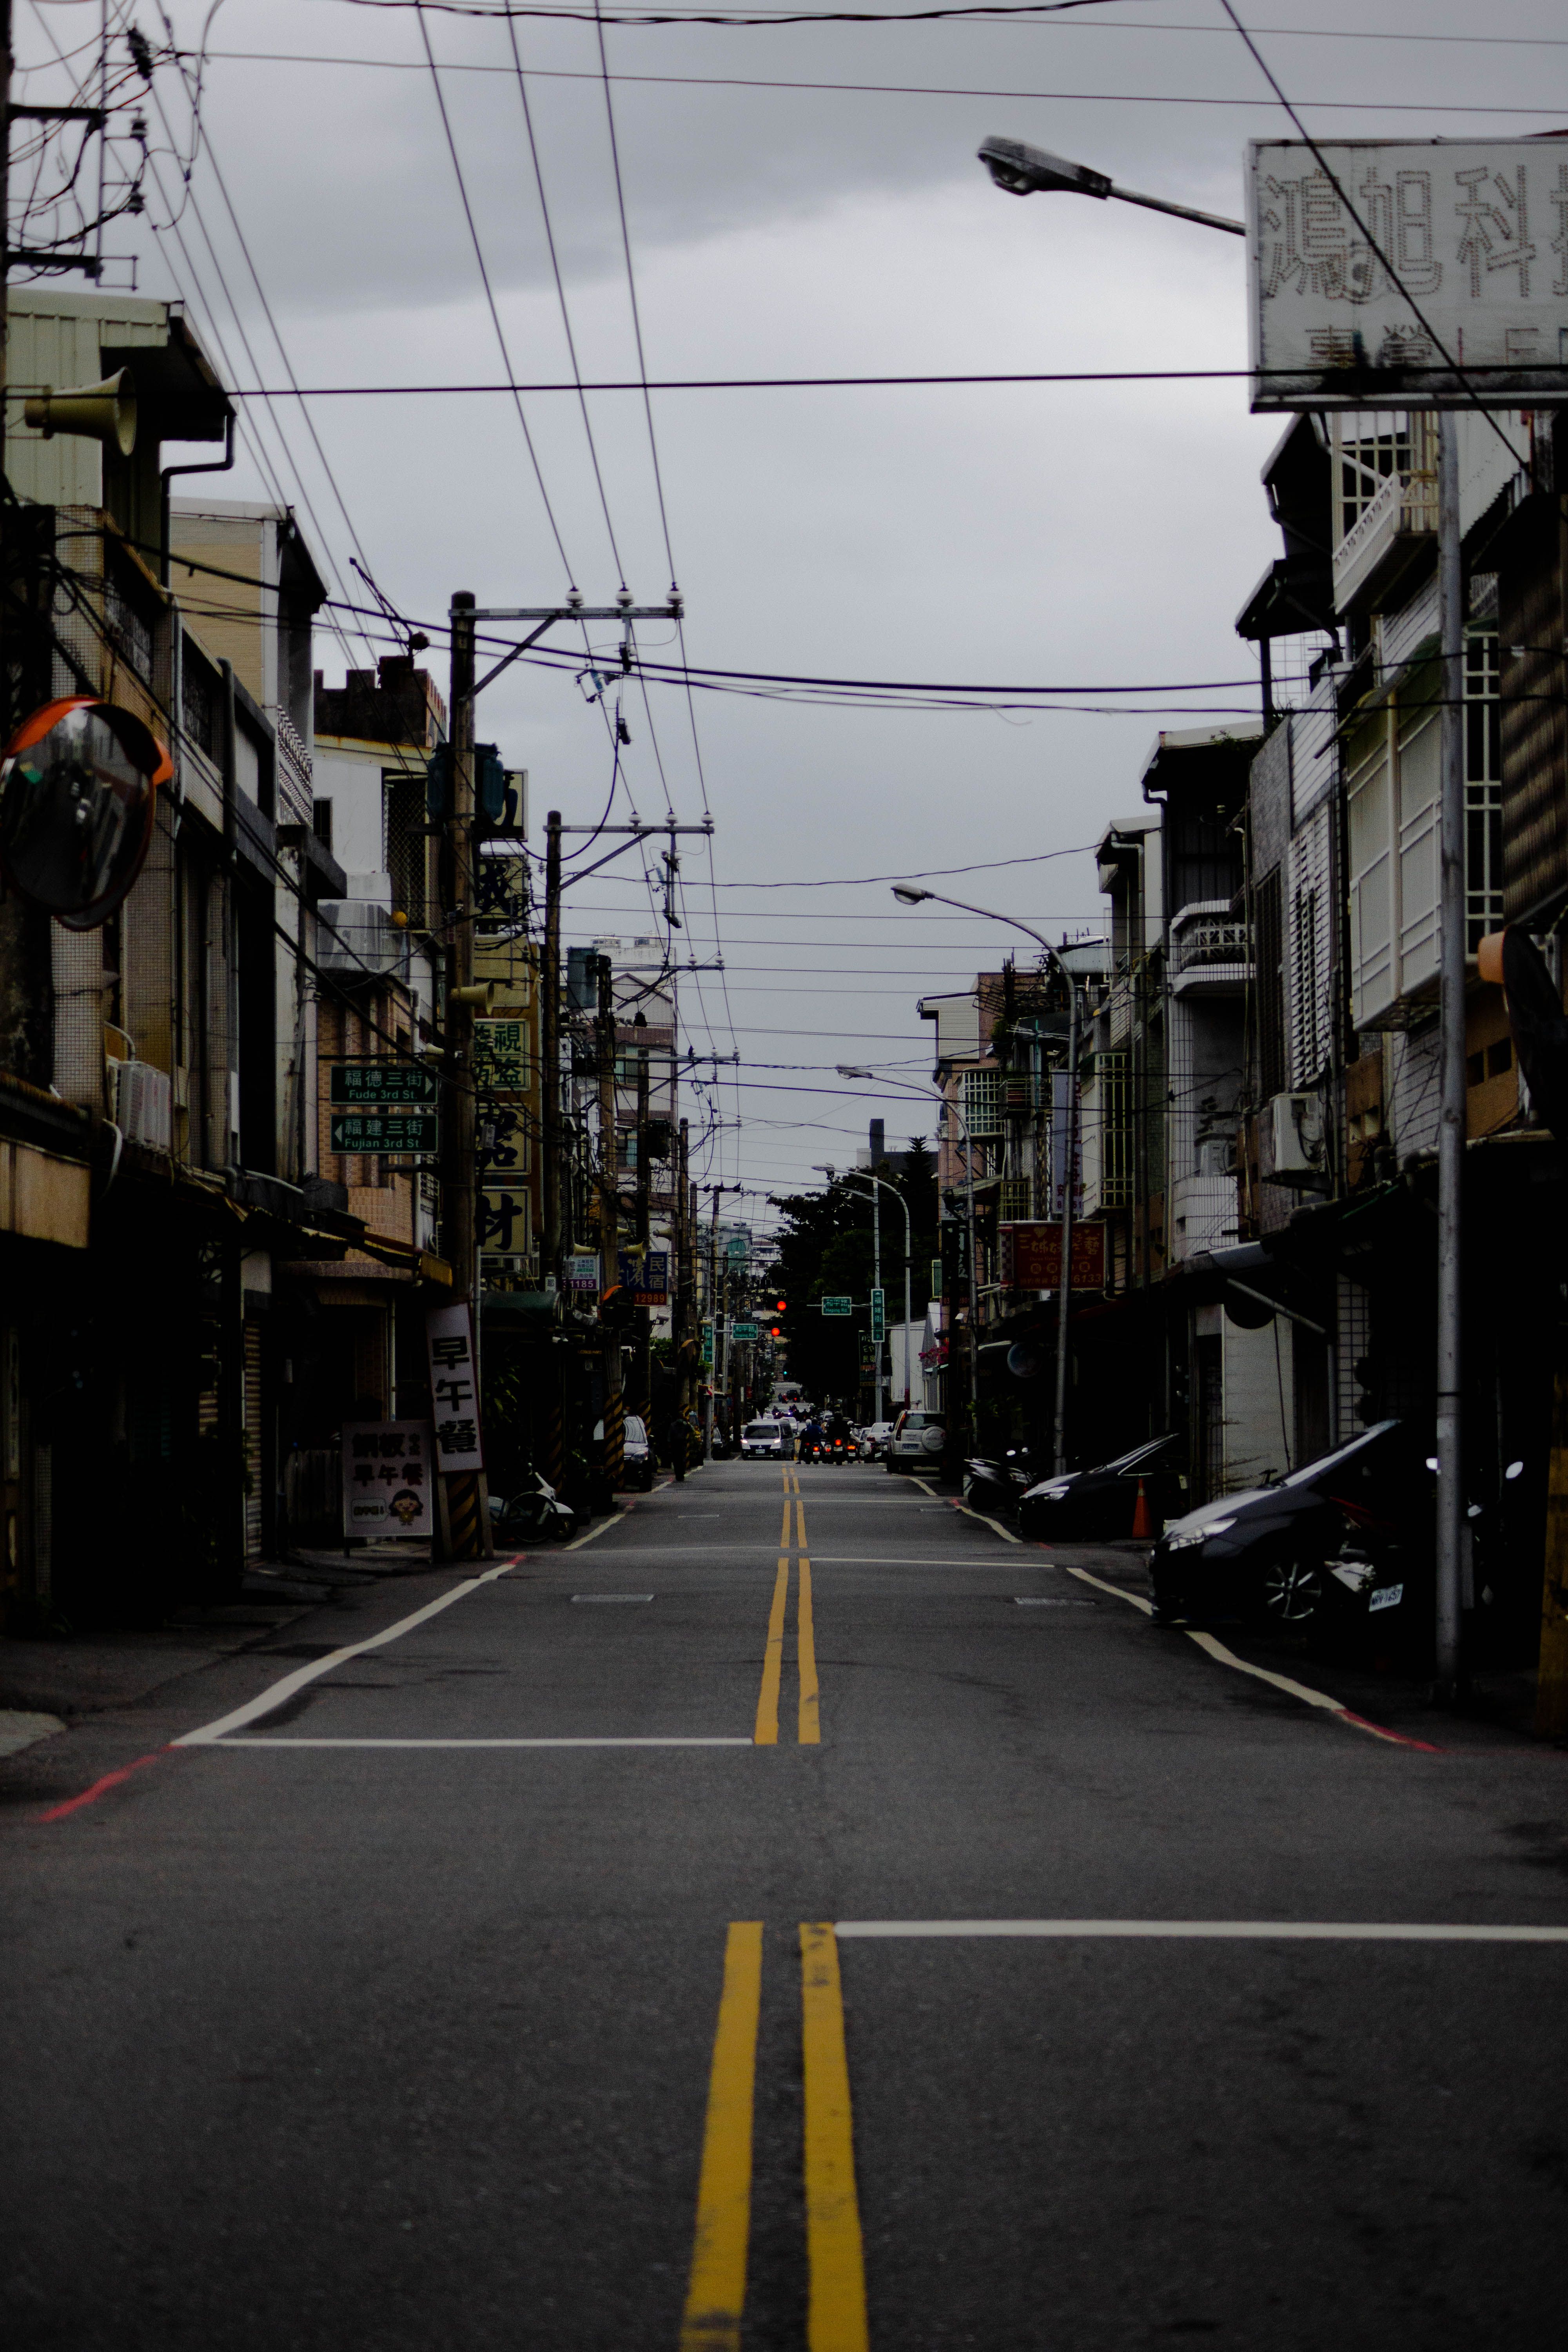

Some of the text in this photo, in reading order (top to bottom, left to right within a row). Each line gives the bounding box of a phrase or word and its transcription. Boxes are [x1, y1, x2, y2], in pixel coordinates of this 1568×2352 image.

[345, 1070, 423, 1088] 福德三街
[349, 1089, 417, 1100] Fude 3rd St.
[345, 1118, 423, 1136] 福建三街
[345, 1138, 423, 1151] Fujian 3rd St.
[649, 1256, 665, 1289] 民宿
[432, 1336, 477, 1454] 早午餐
